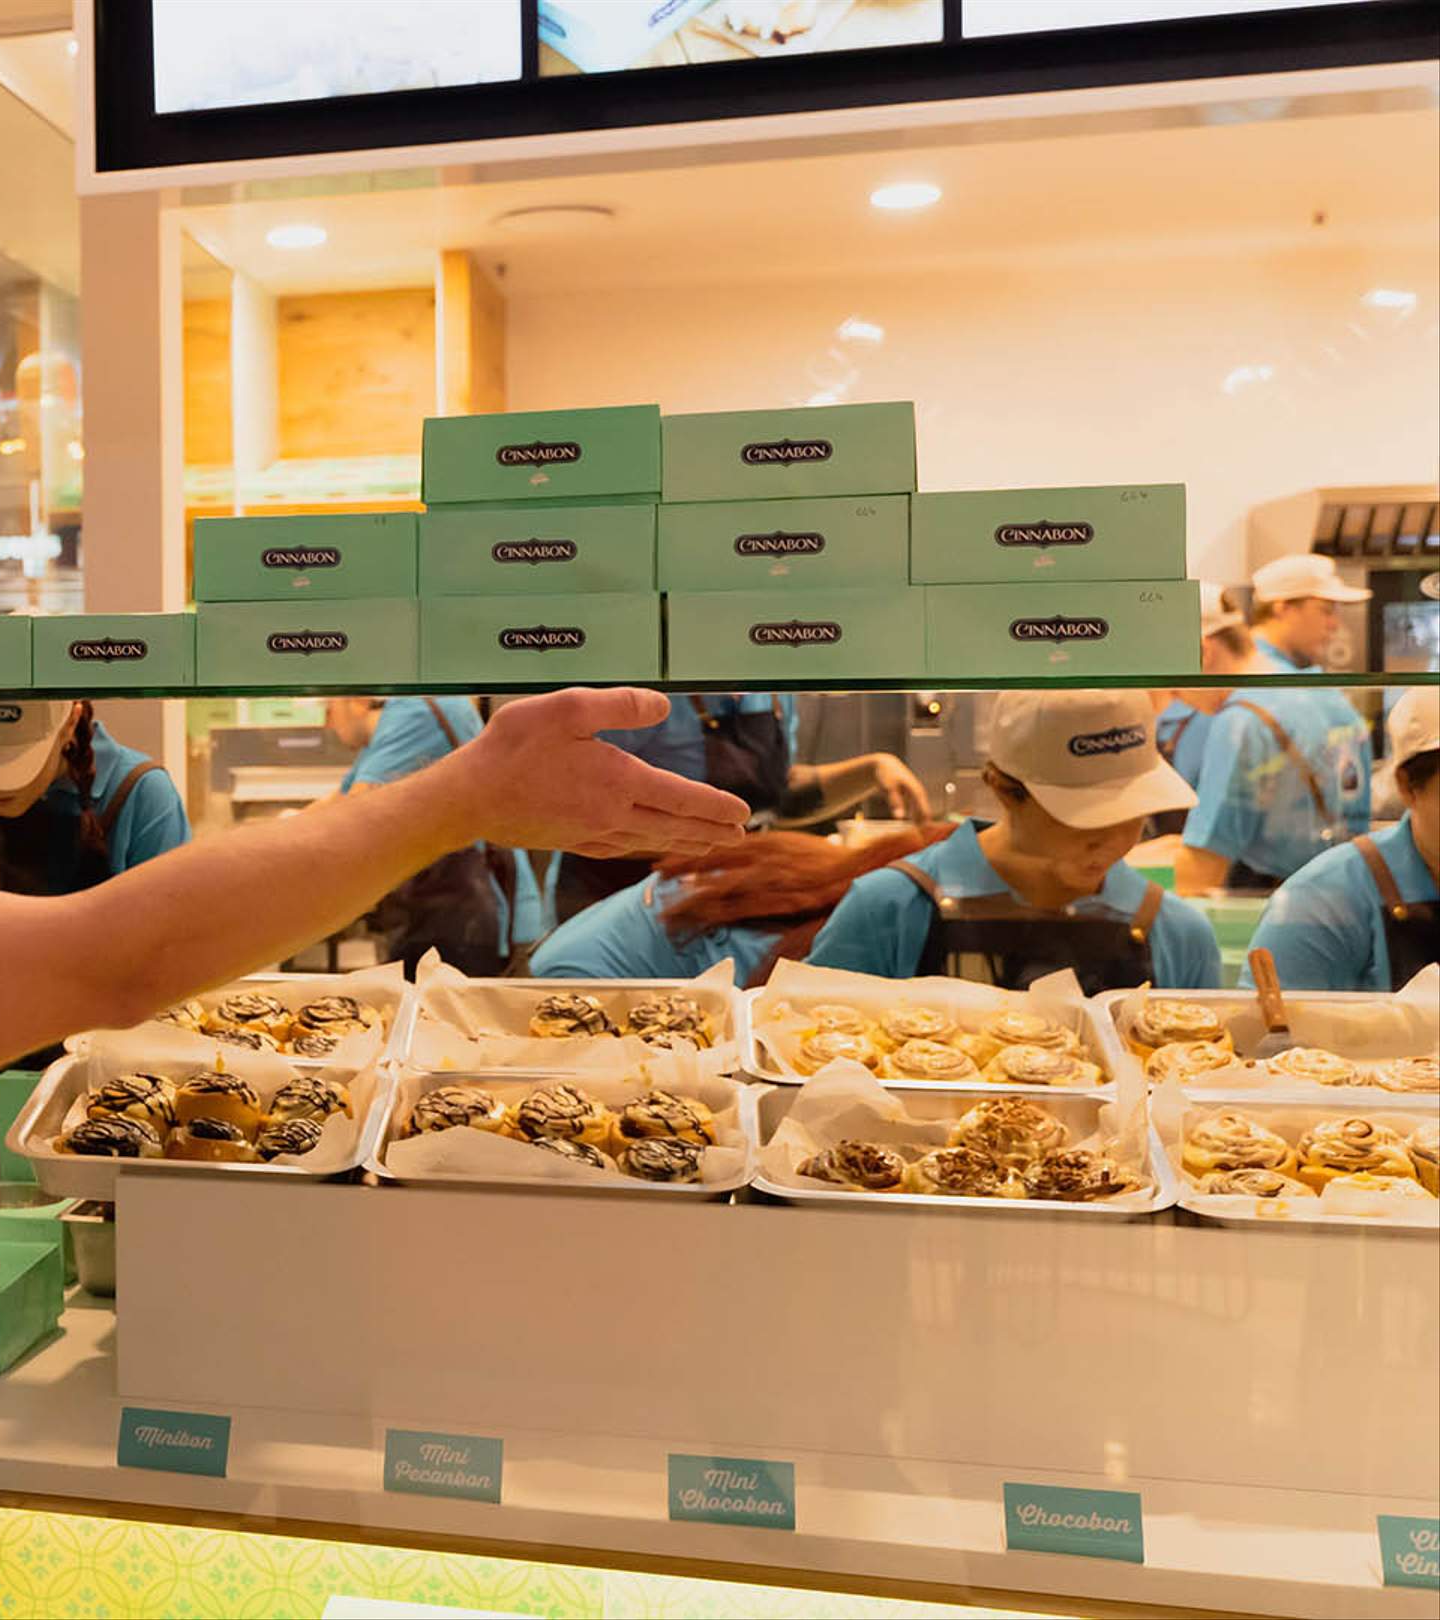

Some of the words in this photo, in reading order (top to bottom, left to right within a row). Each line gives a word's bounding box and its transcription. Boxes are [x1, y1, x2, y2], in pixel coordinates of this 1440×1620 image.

[500, 446, 576, 463] CINNABON
[746, 445, 826, 461] CINNABON
[1000, 527, 1088, 543] CINNABON
[496, 545, 571, 559] CINNABON
[738, 537, 819, 552] CINNABON
[265, 551, 336, 564] CINNABON
[754, 627, 836, 642] CINNABON
[1015, 622, 1102, 638] CINNABON
[271, 636, 342, 649] CINNABON
[503, 632, 579, 646] CINNABON
[72, 644, 143, 657] CINNABON
[135, 1425, 214, 1450] Minibon
[419, 1442, 472, 1465] Mini
[394, 1462, 494, 1490] Pecanbon
[703, 1468, 758, 1491] Mini
[678, 1488, 786, 1517] Chocobon
[1016, 1503, 1134, 1535] Chocobon
